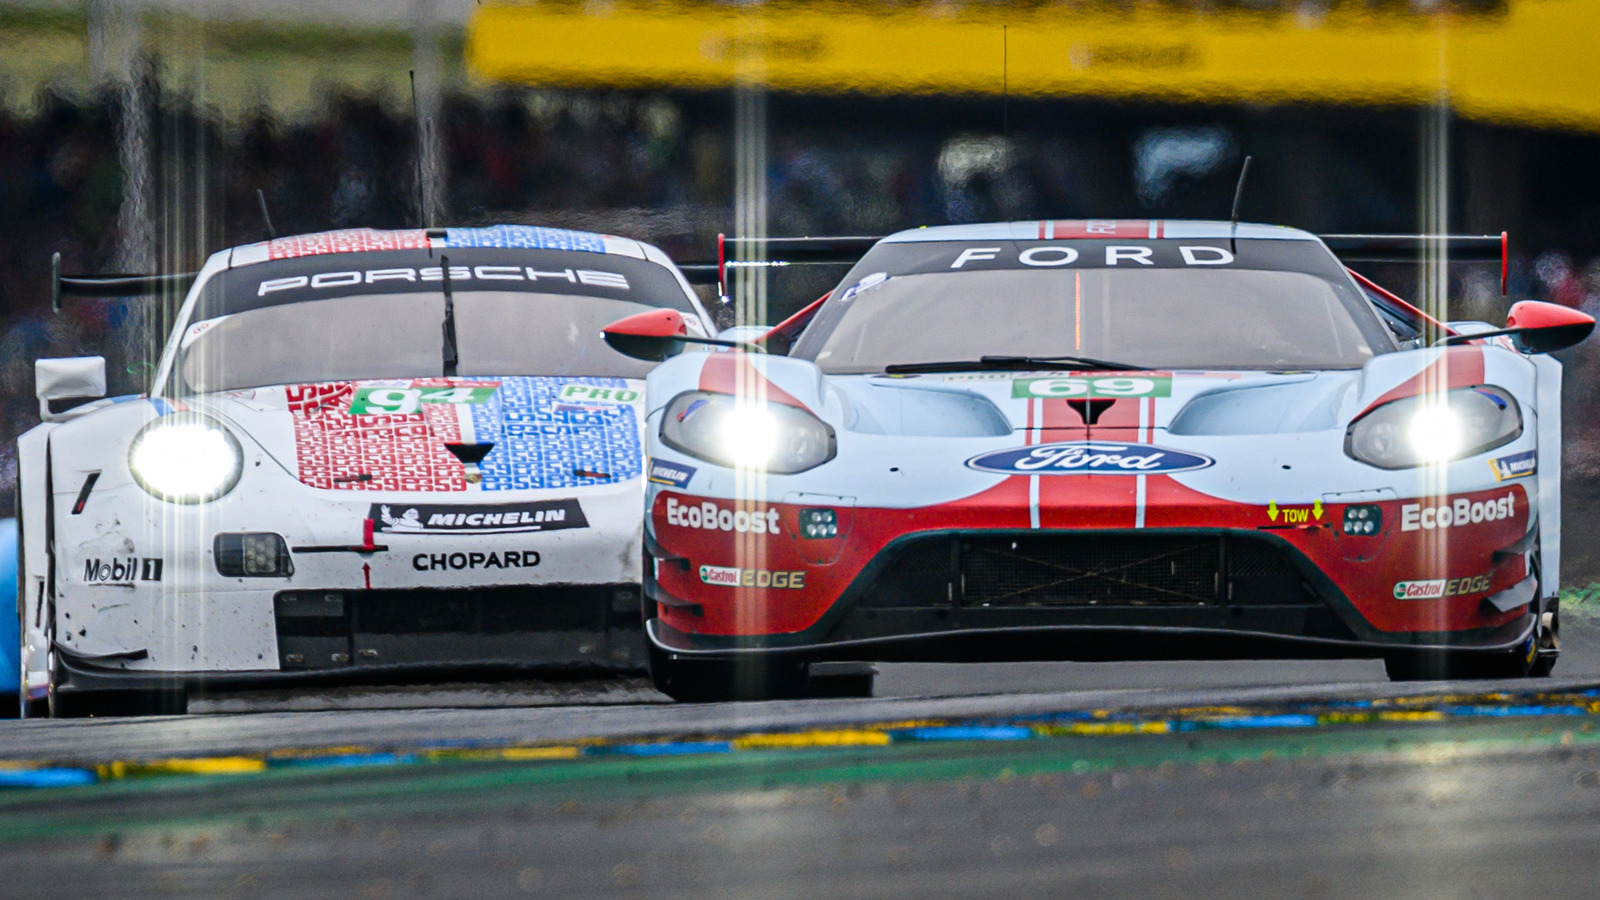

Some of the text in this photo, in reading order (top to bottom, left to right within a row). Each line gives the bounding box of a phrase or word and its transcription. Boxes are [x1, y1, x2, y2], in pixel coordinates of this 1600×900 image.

[950, 245, 1235, 269] FORD
[258, 265, 630, 297] PORSCHE
[565, 386, 639, 402] PRO
[1028, 377, 1155, 397] 69
[365, 388, 475, 415] 94
[1014, 445, 1165, 470] Ford
[427, 509, 565, 526] MICHELIN
[666, 497, 780, 535] EcoBoost
[1282, 508, 1309, 523] TOW
[1401, 491, 1515, 532] EcoBoost
[83, 557, 138, 581] Mobil
[412, 551, 541, 571] CHOPARD
[708, 569, 807, 588] Castrol EDGE
[1406, 574, 1493, 596] Castrol EDGE
